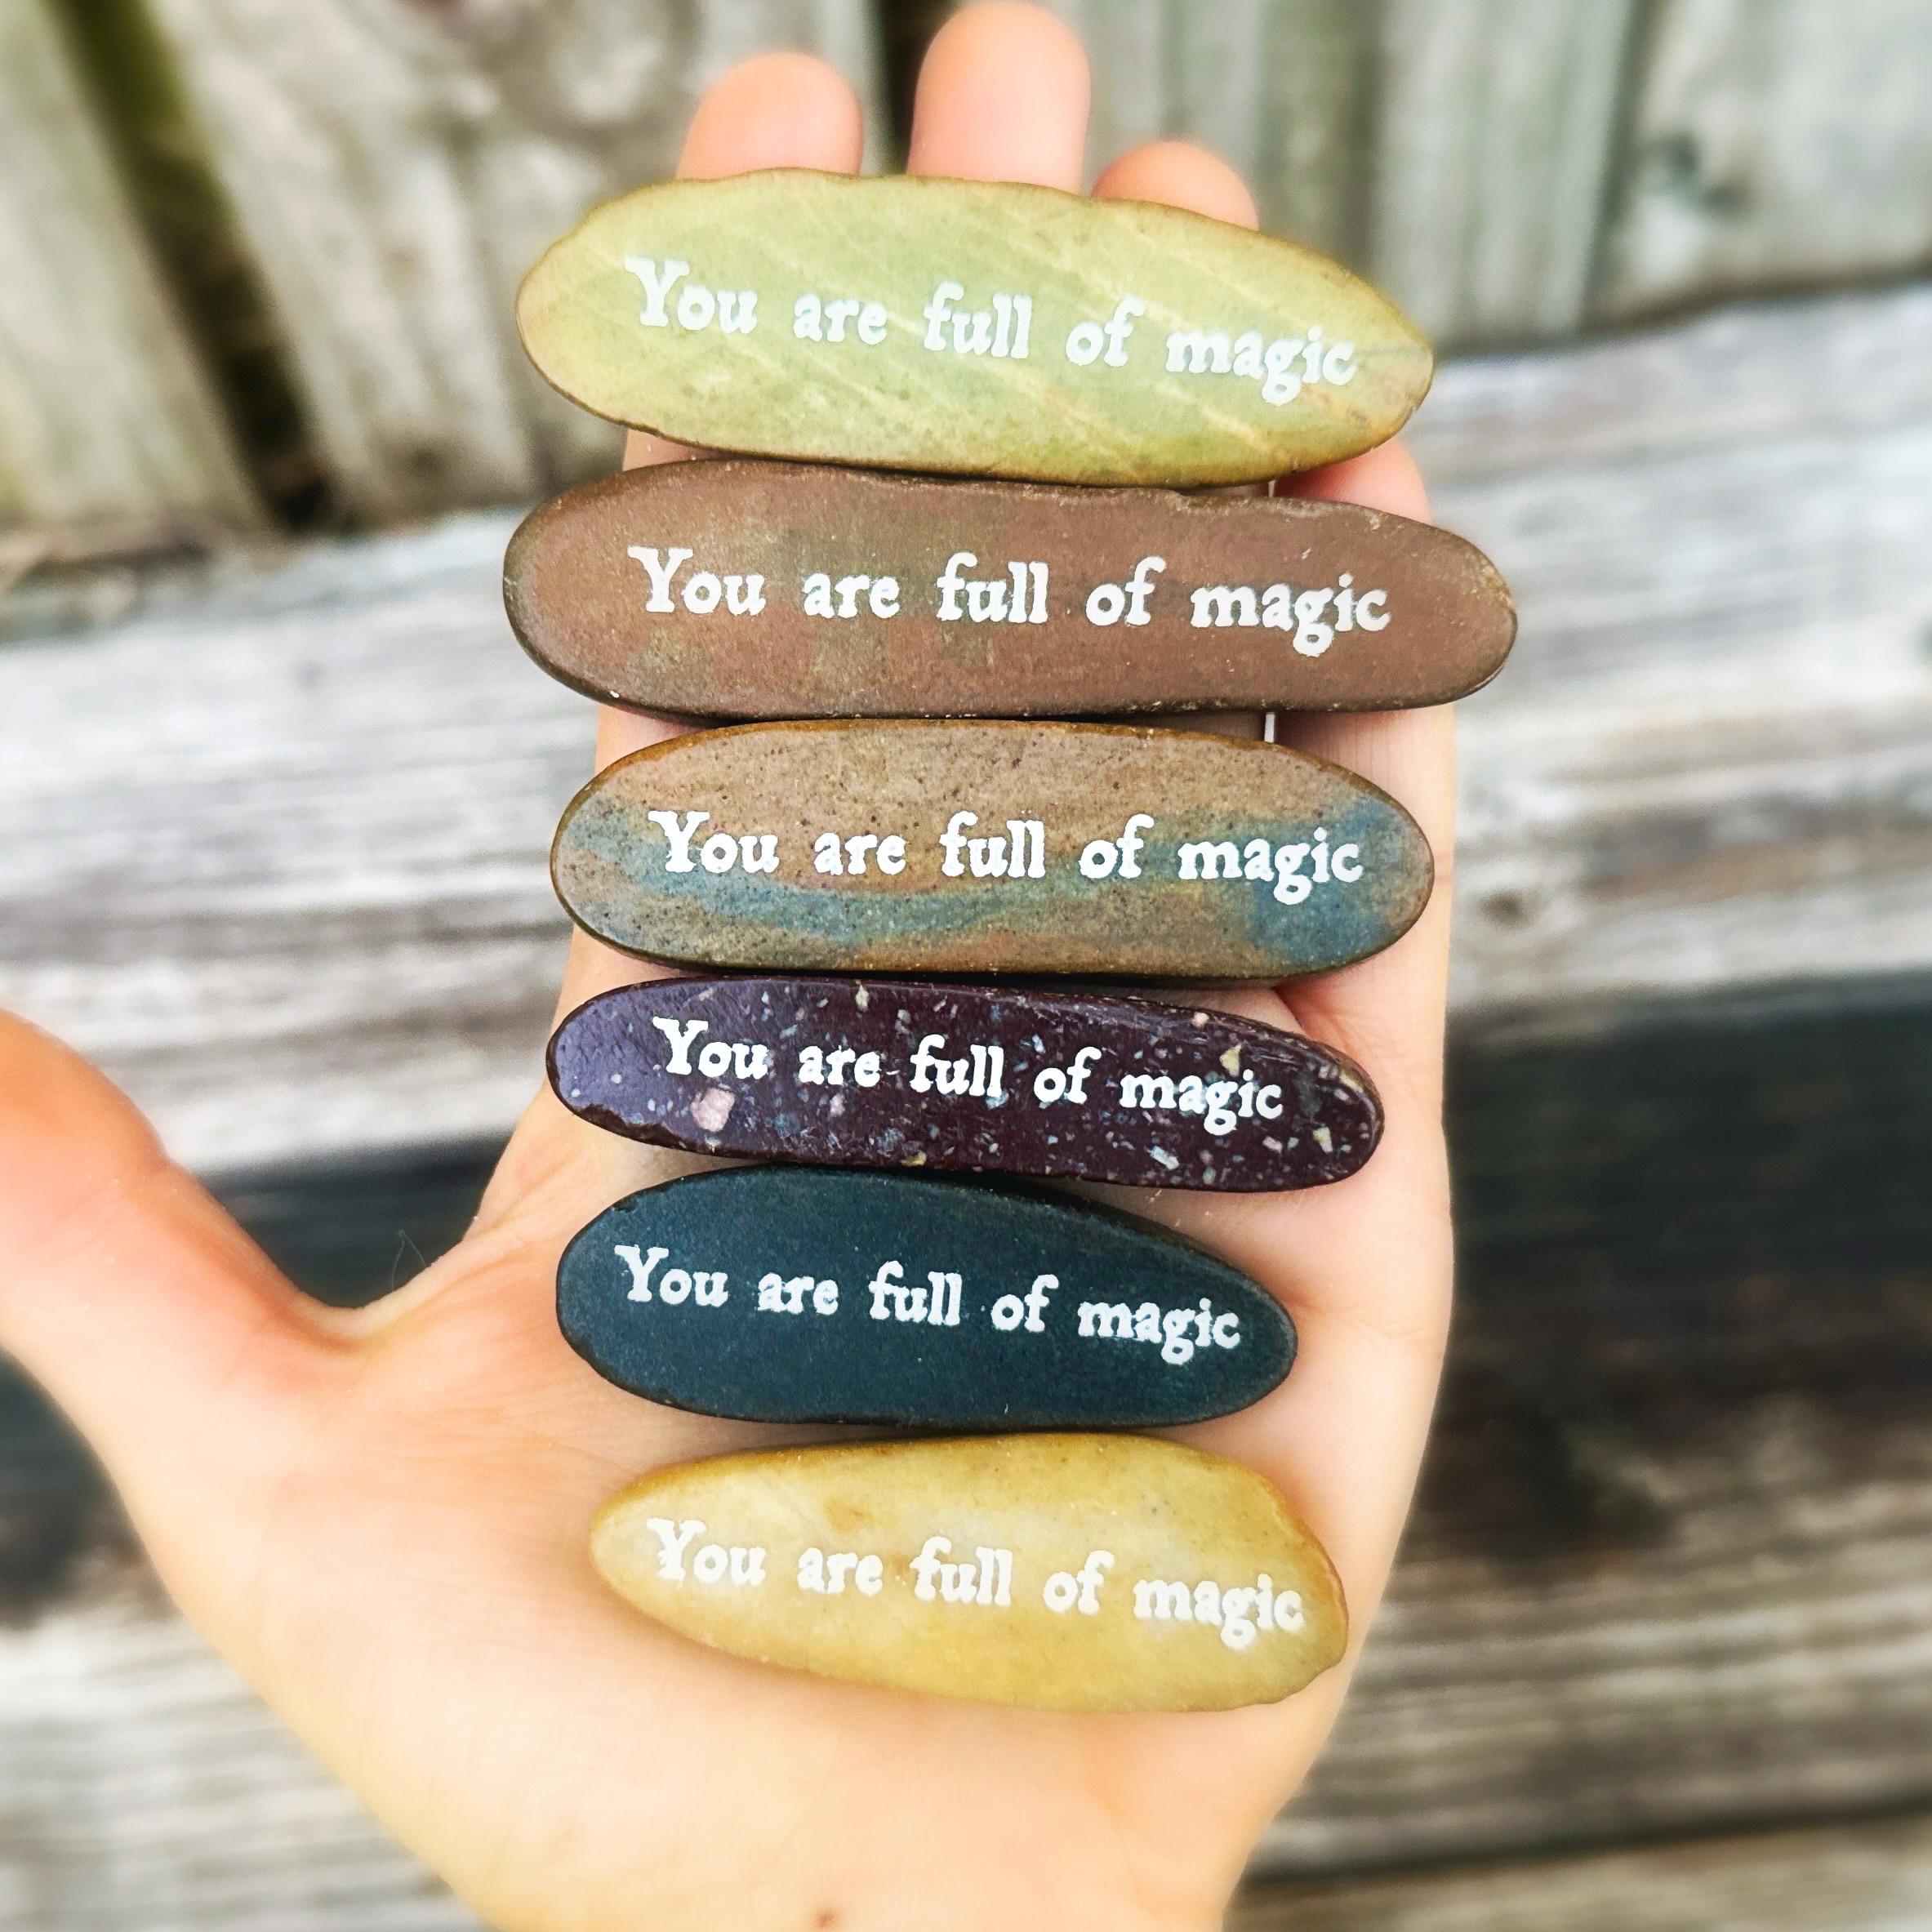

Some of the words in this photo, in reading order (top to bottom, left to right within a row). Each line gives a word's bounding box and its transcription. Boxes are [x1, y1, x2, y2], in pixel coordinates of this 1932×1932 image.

[624, 256, 759, 335] You
[793, 292, 888, 345] are
[924, 283, 1032, 360] full
[1066, 296, 1146, 367] of
[1165, 325, 1357, 407] magic
[628, 545, 766, 616] You
[804, 572, 900, 618] are
[937, 552, 1048, 625] full
[1085, 556, 1167, 627] of
[1190, 574, 1390, 657] magic
[648, 811, 780, 874] You
[814, 831, 906, 875] are
[939, 811, 1044, 879] full
[1080, 814, 1155, 879] of
[1177, 827, 1364, 906] magic
[653, 1017, 768, 1080] You
[799, 1044, 881, 1087] are
[910, 1035, 1004, 1097] full
[1035, 1047, 1102, 1104] of
[1120, 1068, 1283, 1136] magic
[615, 1245, 728, 1308] You
[757, 1272, 839, 1315] are
[869, 1260, 961, 1326] full
[991, 1274, 1060, 1333] of
[1077, 1297, 1241, 1365] magic
[646, 1517, 764, 1587] You
[797, 1547, 883, 1595] are
[910, 1537, 1012, 1608] full
[1043, 1551, 1114, 1614] of
[1133, 1574, 1305, 1650] magic
